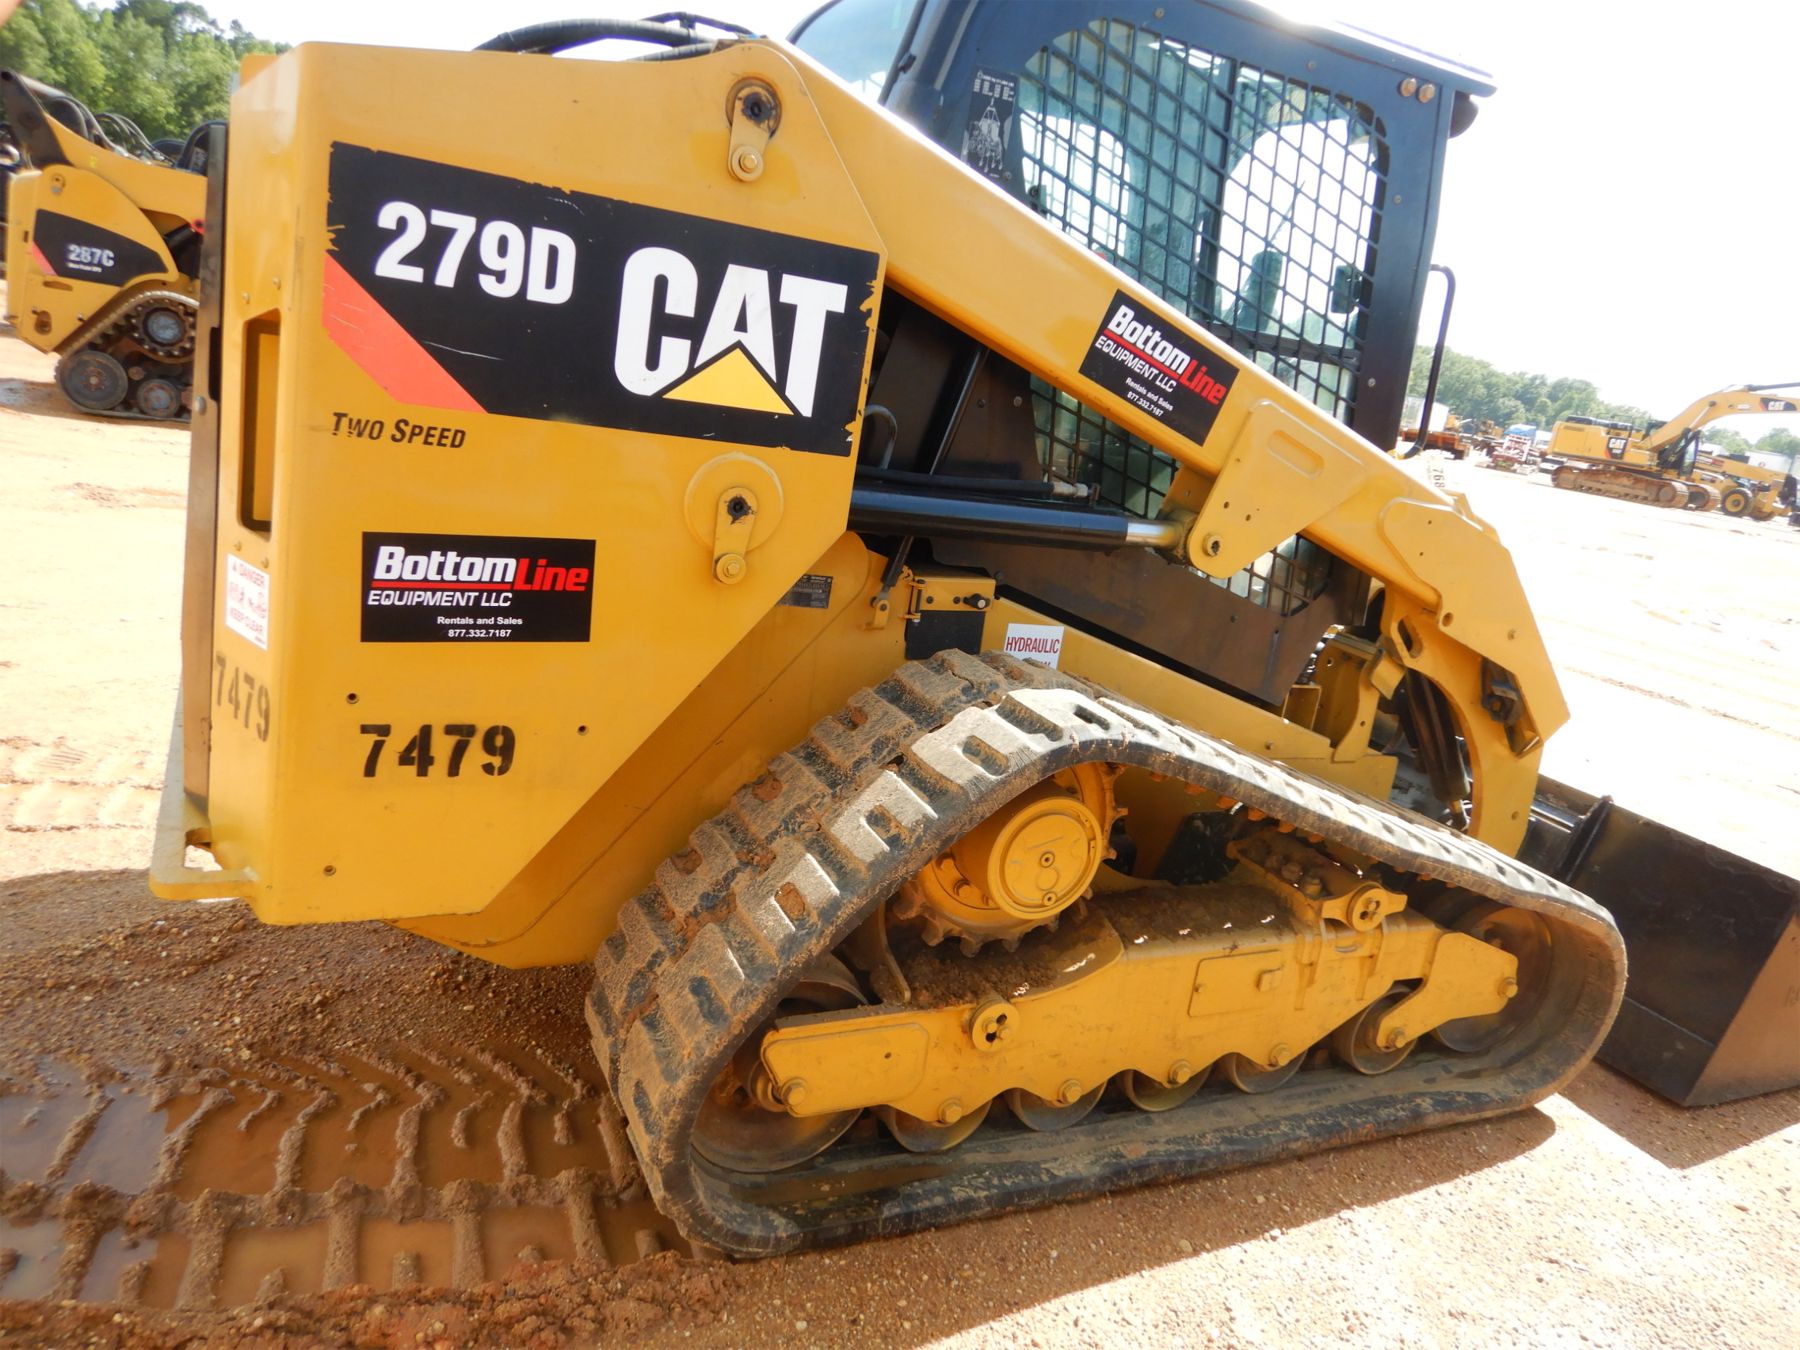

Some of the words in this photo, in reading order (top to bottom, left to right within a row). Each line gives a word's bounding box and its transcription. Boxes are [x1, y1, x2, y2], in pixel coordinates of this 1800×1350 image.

[68, 244, 115, 267] 287C
[375, 201, 577, 304] 279D
[614, 246, 848, 418] CAT
[1095, 335, 1159, 380] EQUIPMENT
[1155, 373, 1177, 392] LLC
[367, 590, 479, 606] EQUIPMENT
[480, 592, 513, 607] LLC
[437, 616, 474, 625] Rentals
[476, 616, 495, 625] and
[496, 616, 523, 625] Sales
[447, 629, 512, 637] 877.332.7187
[1005, 636, 1060, 654] HYDRAULIC
[216, 654, 271, 743] 7479
[360, 724, 516, 778] 7479
